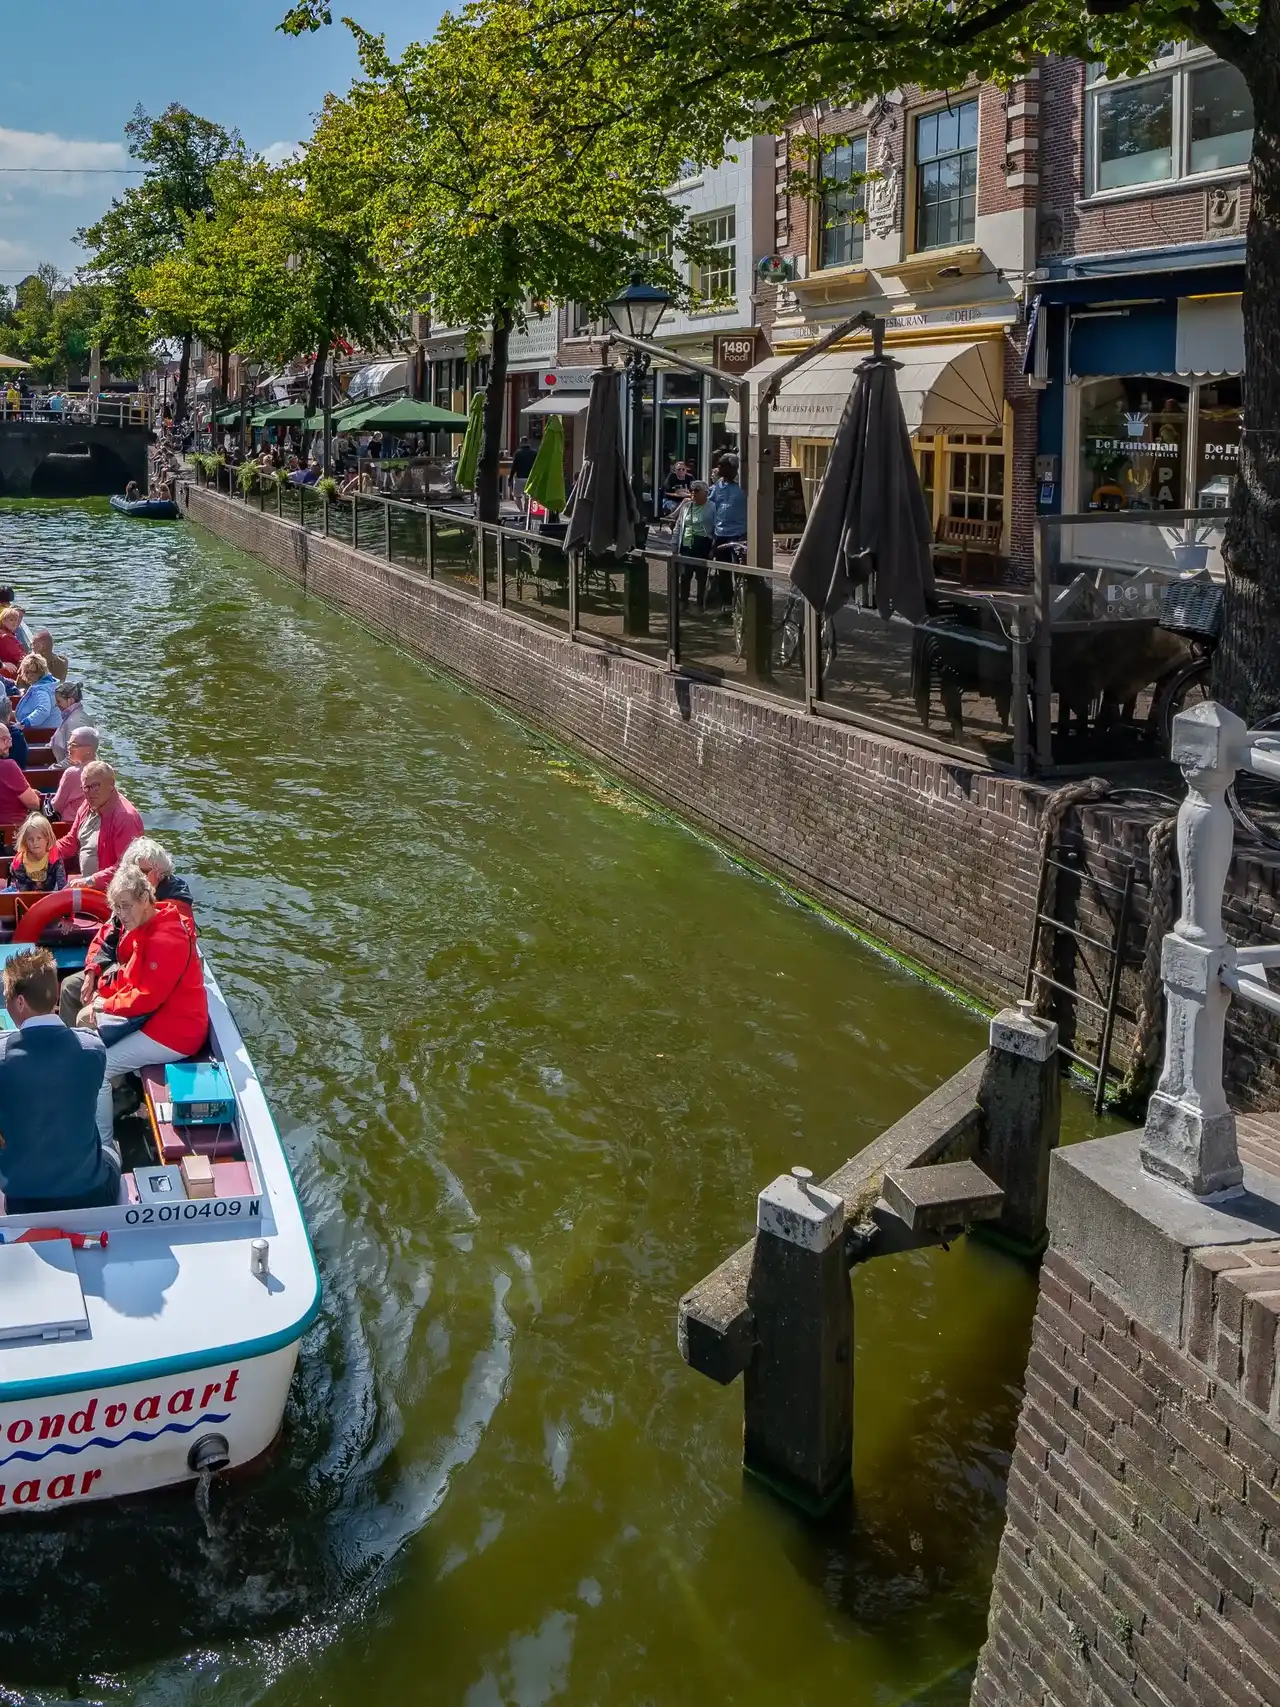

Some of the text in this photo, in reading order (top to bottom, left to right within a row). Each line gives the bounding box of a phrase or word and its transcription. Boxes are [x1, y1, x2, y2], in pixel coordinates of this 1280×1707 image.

[884, 315, 928, 328] ESTAURANT
[722, 341, 751, 354] 1480
[792, 405, 834, 413] RESTAURANT
[1095, 439, 1178, 452] De Fransman
[1205, 443, 1223, 454] De
[1107, 584, 1138, 602] De
[125, 1200, 260, 1225] 02010409 N
